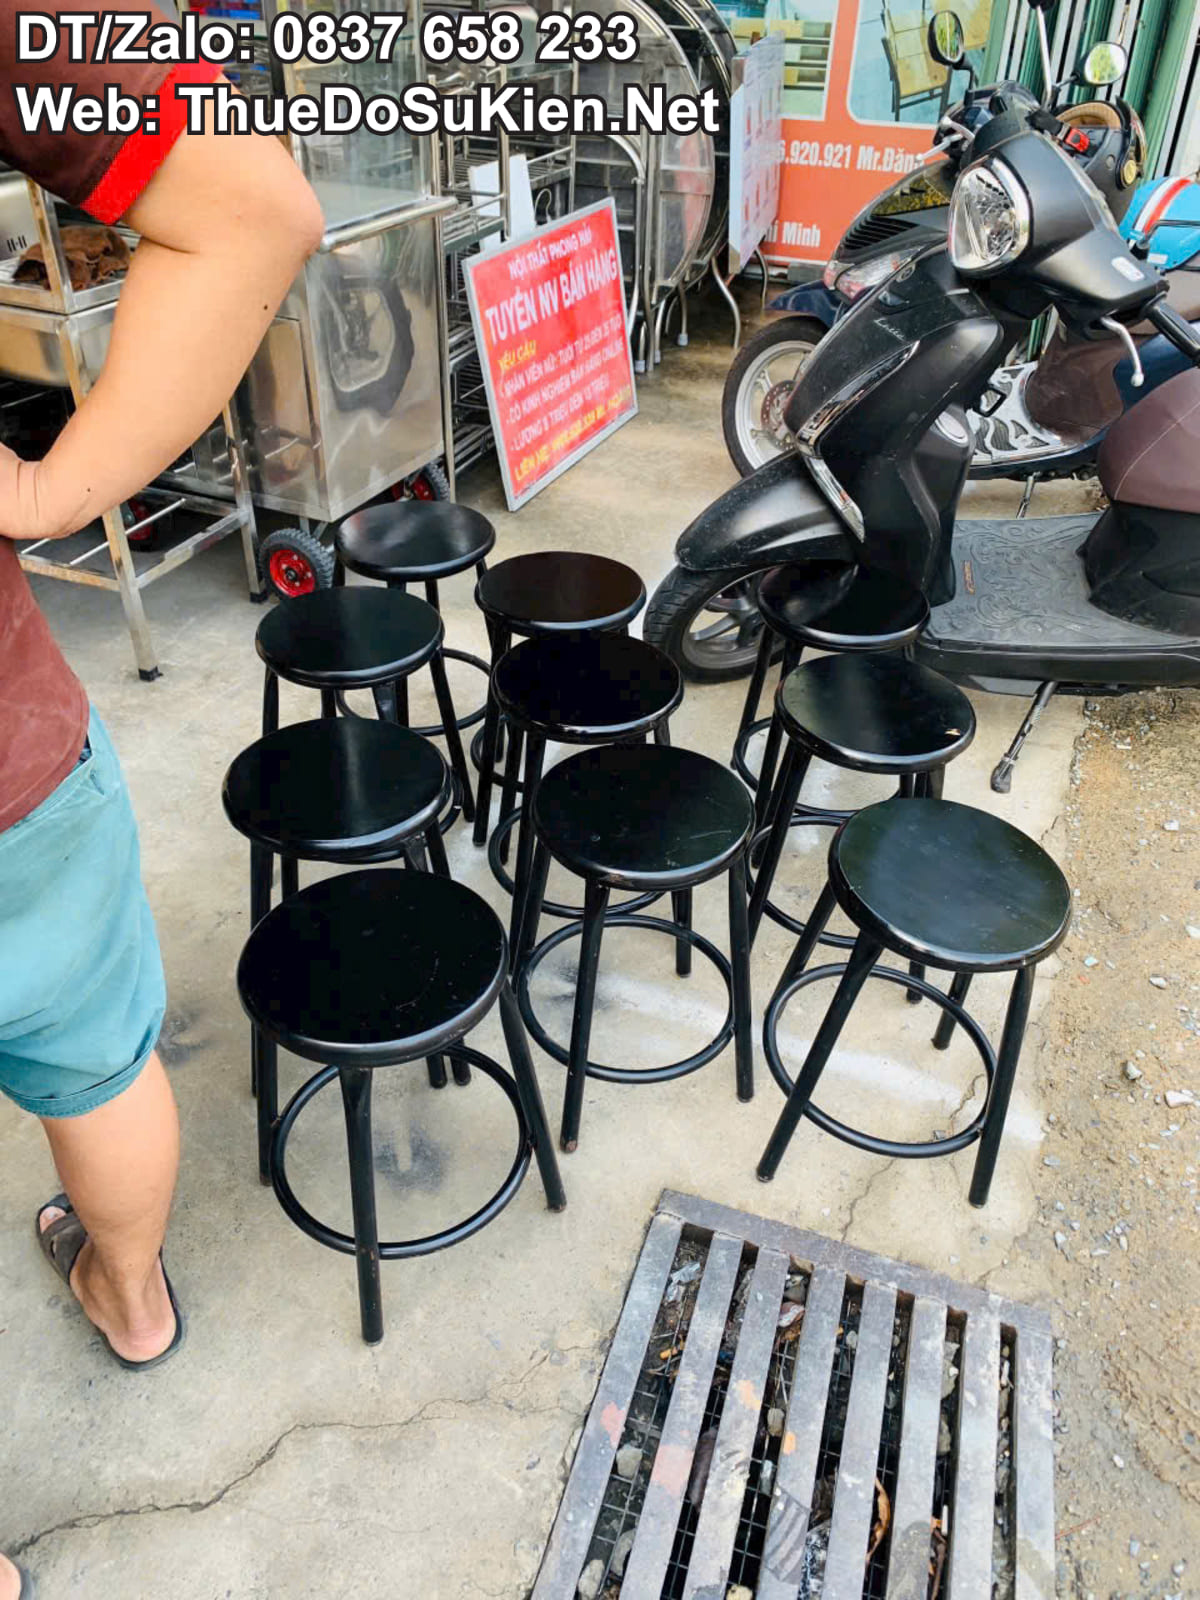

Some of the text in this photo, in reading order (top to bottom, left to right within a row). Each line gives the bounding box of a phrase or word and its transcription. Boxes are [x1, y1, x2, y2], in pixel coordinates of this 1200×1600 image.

[782, 221, 821, 248] Minh
[538, 277, 560, 319] NV
[560, 263, 586, 307] BÁN
[587, 247, 617, 291] HÀNG
